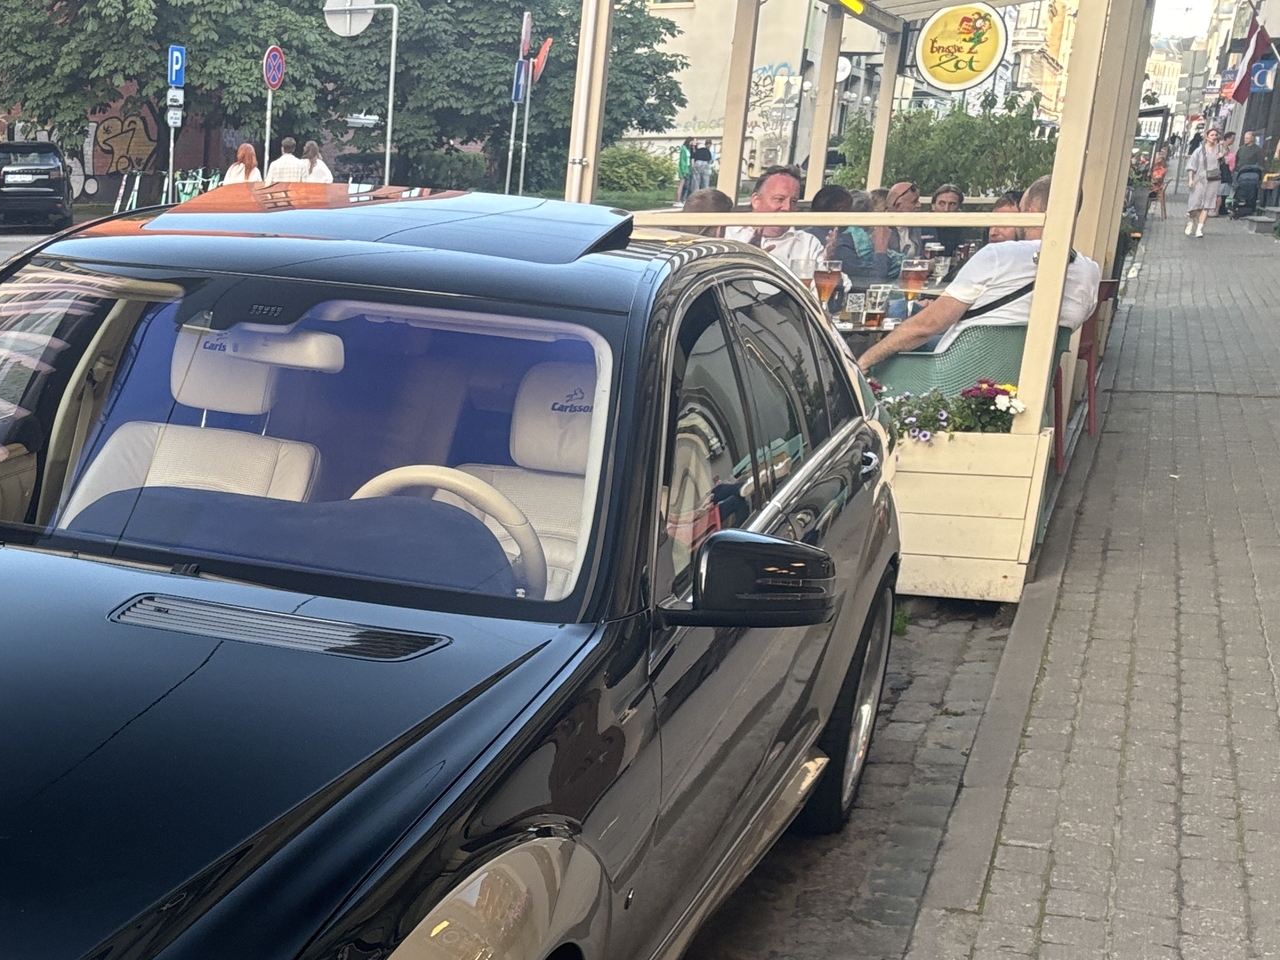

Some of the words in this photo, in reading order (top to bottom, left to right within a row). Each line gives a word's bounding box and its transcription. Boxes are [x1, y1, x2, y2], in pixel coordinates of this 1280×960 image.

[172, 51, 182, 81] P
[929, 55, 983, 73] Zot
[202, 340, 227, 352] Carls
